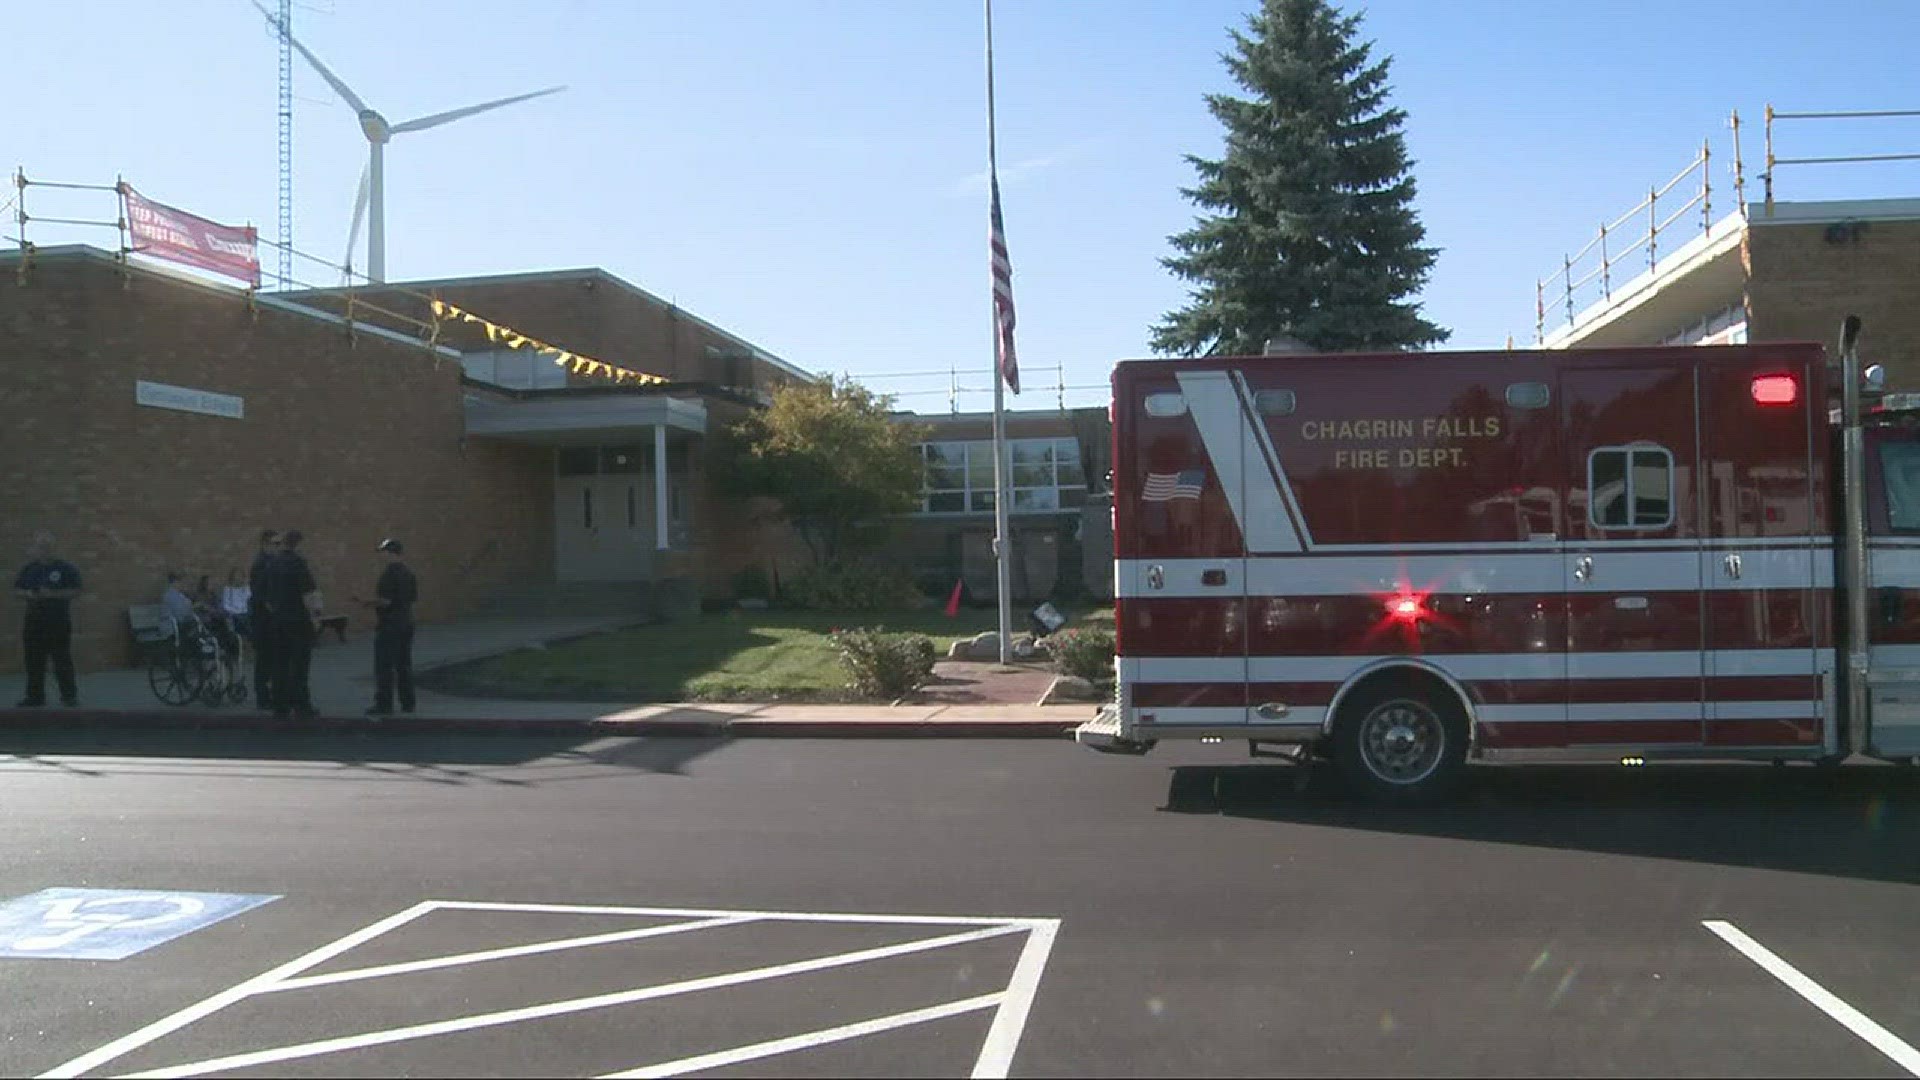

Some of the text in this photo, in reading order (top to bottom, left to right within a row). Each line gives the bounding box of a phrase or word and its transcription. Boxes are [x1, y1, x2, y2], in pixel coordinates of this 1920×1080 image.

[1301, 417, 1500, 440] CHAGRIN FALLS
[1335, 448, 1467, 468] FIRE DEPT.
